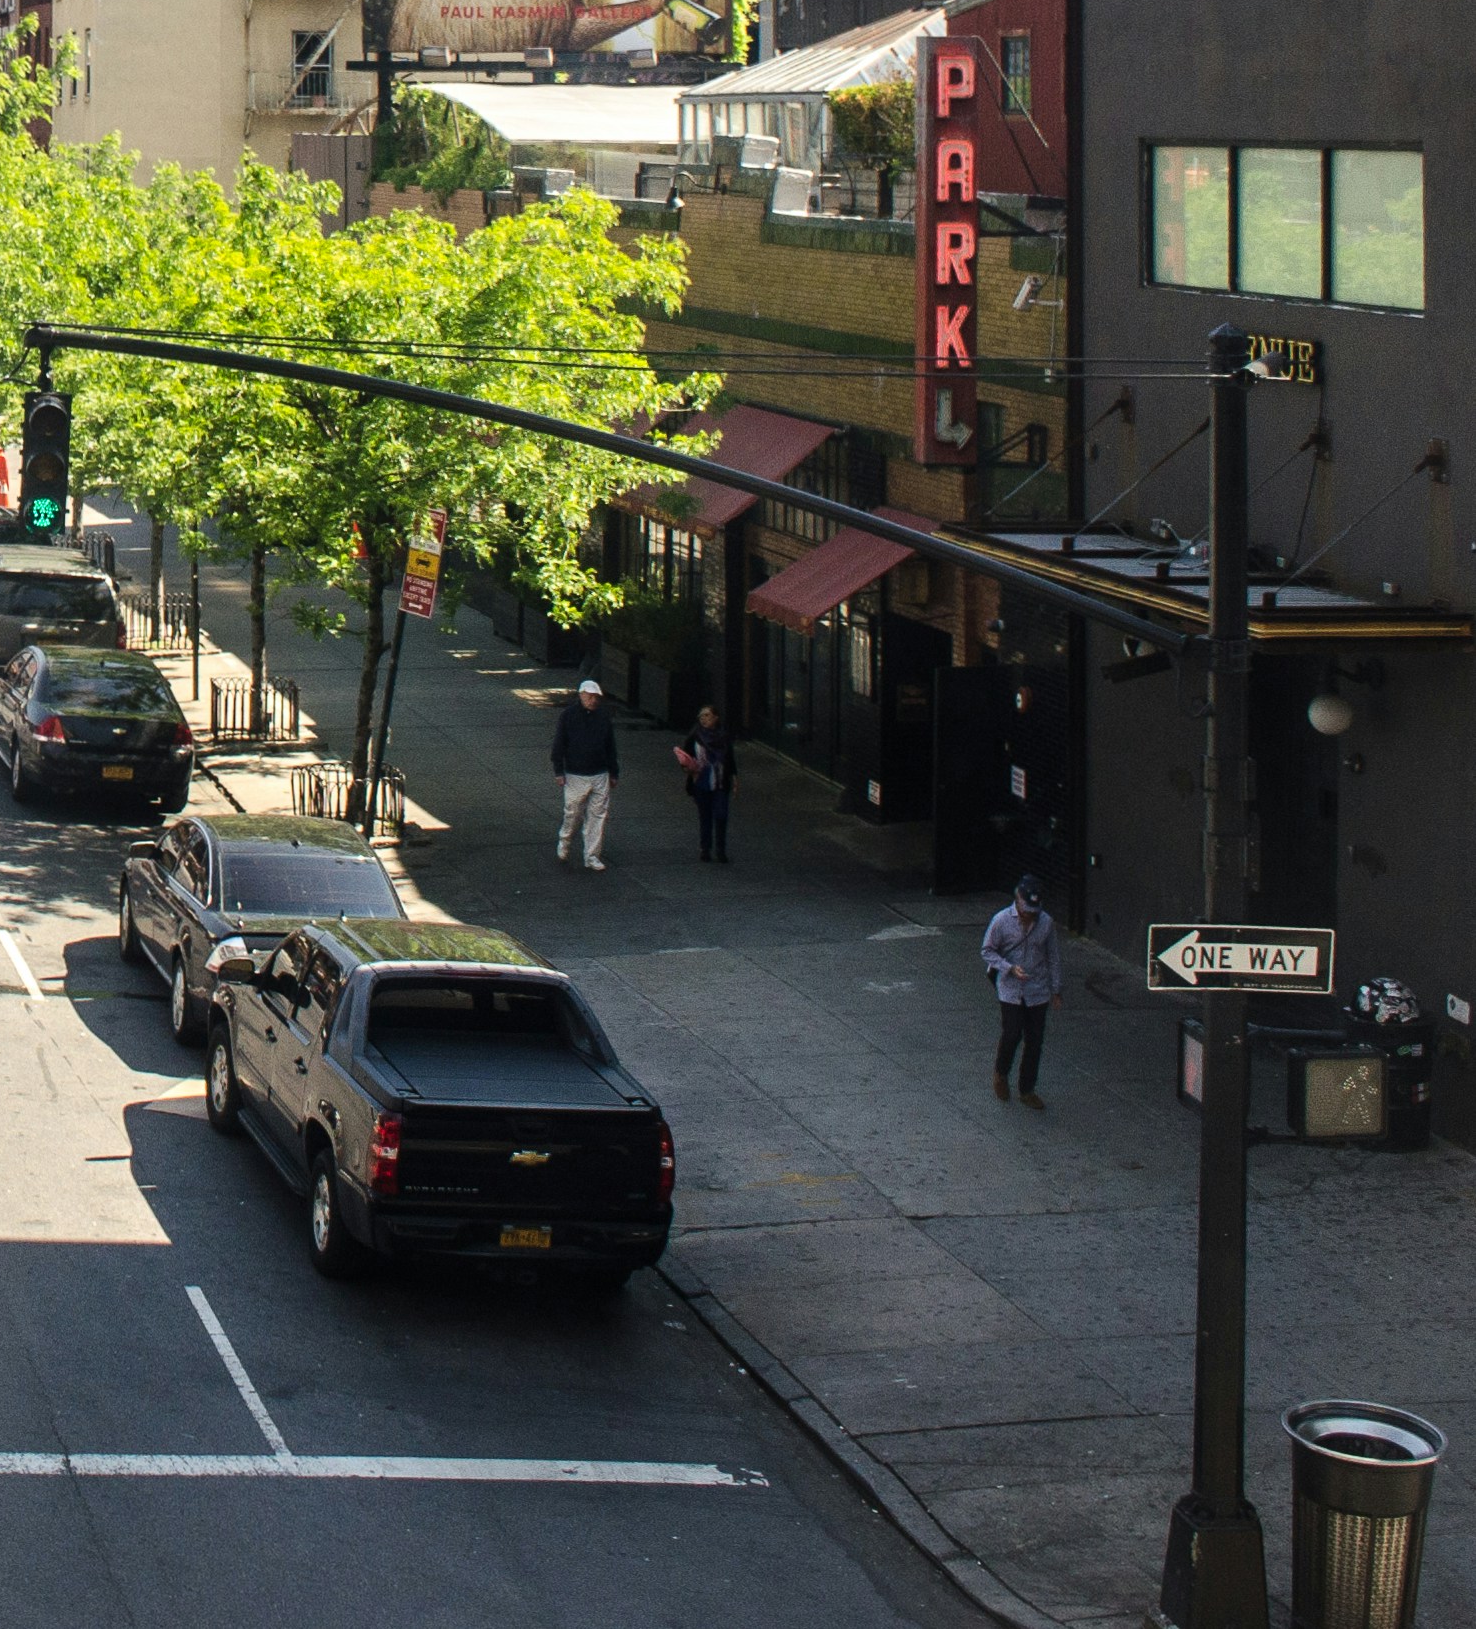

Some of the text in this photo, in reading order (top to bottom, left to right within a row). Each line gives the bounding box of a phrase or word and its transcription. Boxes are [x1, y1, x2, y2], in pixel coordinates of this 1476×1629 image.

[440, 6, 485, 19] PAUL
[492, 6, 568, 20] KASMIN
[934, 53, 977, 368] PARK
[1181, 945, 1305, 972] ONE WAY
